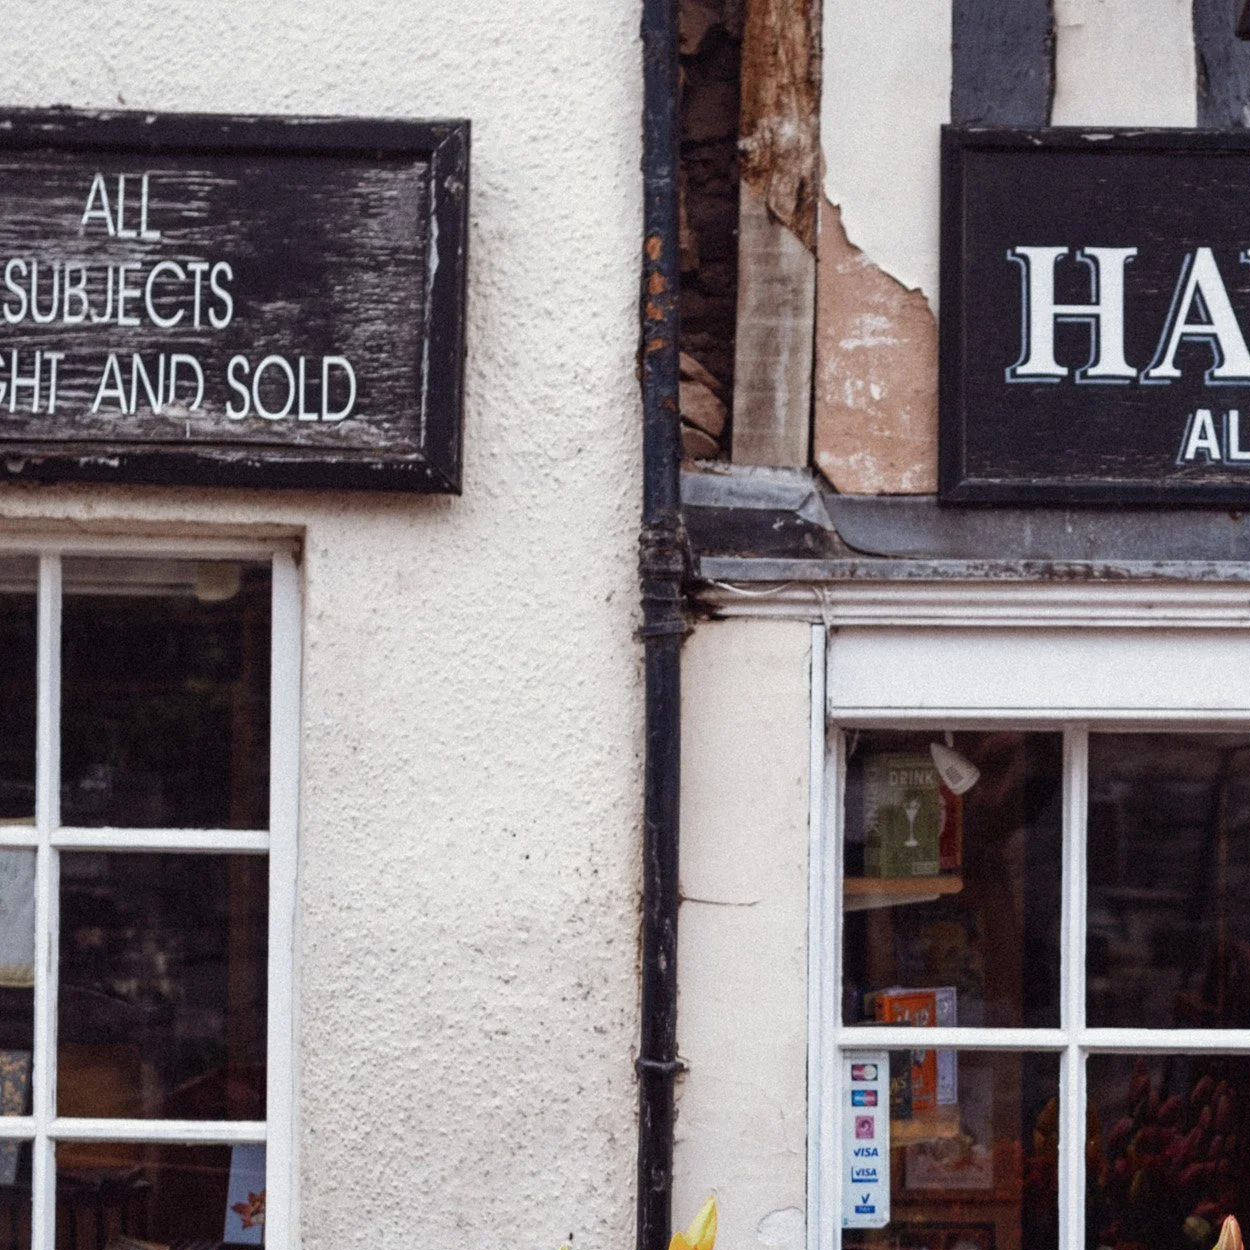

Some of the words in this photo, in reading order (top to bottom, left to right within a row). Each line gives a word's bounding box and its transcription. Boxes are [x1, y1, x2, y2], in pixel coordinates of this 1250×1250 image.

[82, 172, 161, 240] ALL
[2, 258, 235, 329] SUBJECTS
[0, 348, 66, 415] HT
[91, 352, 204, 415] AND
[225, 354, 358, 421] SOLD
[887, 769, 934, 786] DRINK
[853, 1147, 879, 1157] VISA
[855, 1168, 877, 1177] VISA
